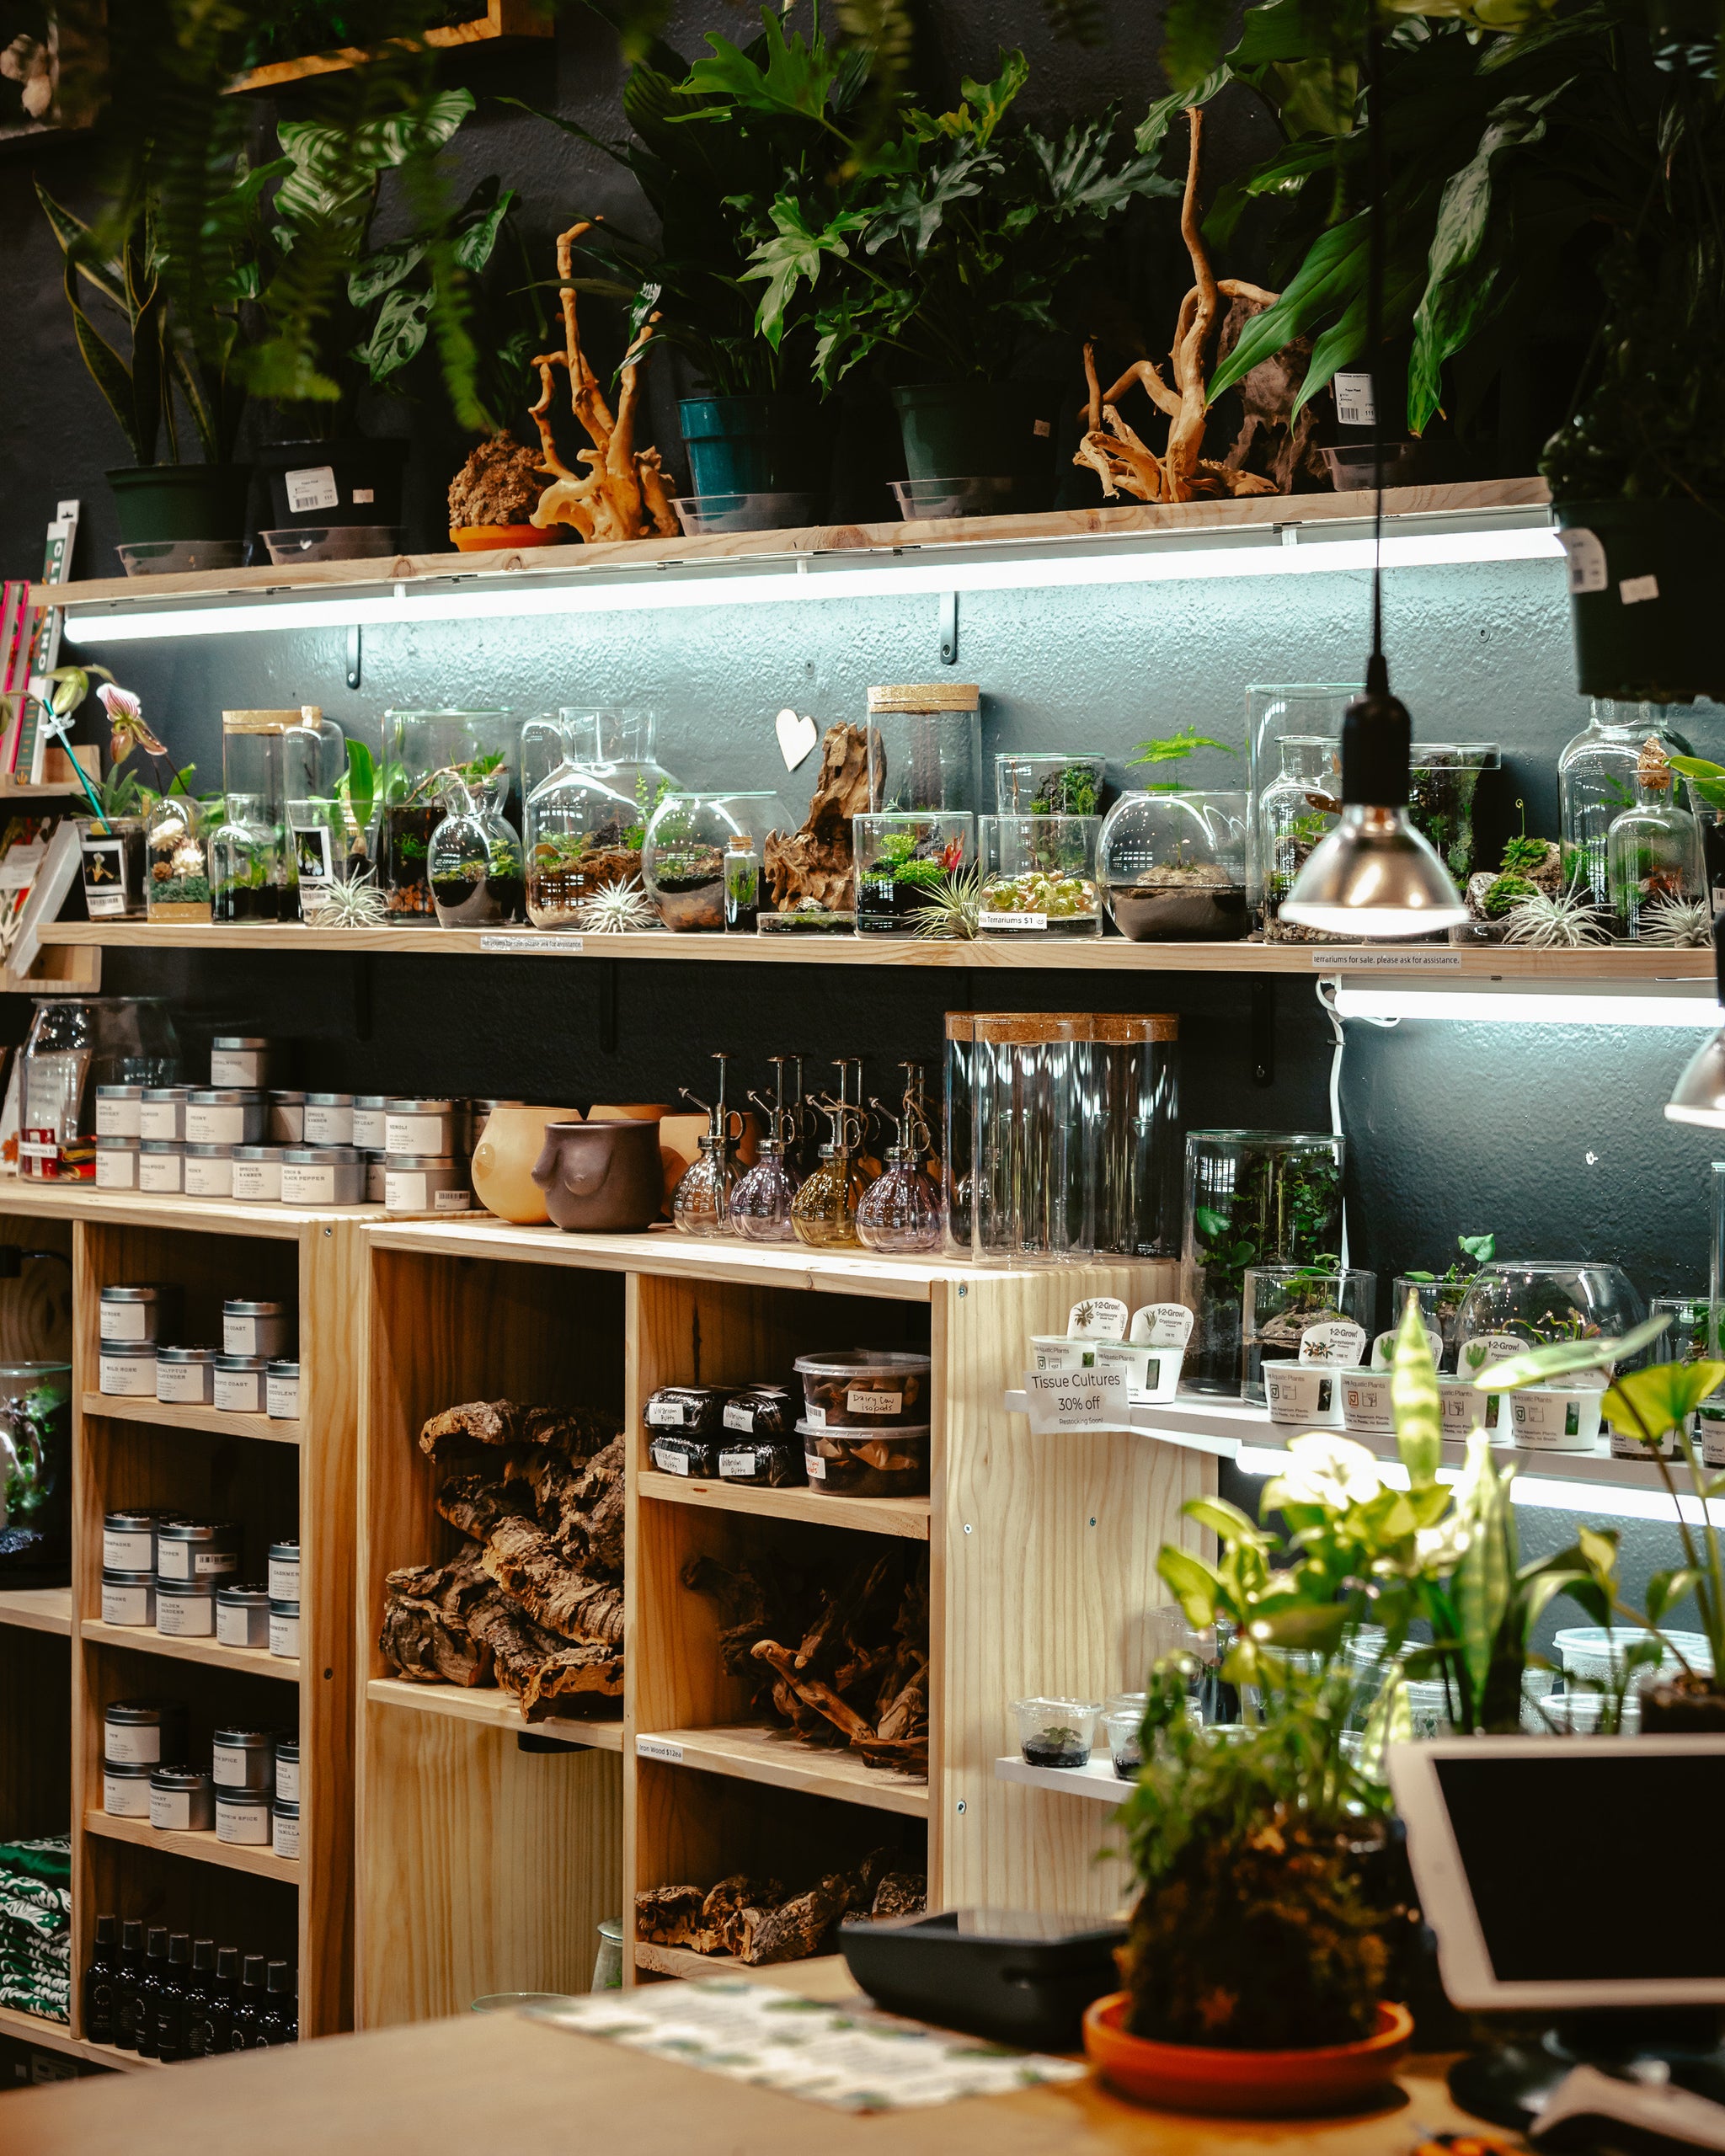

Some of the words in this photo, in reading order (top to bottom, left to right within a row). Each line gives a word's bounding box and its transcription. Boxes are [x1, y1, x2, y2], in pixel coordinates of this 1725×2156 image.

[1313, 955, 1347, 963] terrariums
[1348, 955, 1358, 963] for
[1376, 956, 1398, 965] please
[1412, 956, 1422, 964] for
[1094, 1301, 1120, 1310] 1-2-Grow!
[1157, 1308, 1185, 1318] 1-2-Grow!
[1329, 1327, 1358, 1338] 1-2-Grow!
[1487, 1341, 1520, 1352] 1-2-Grow!
[1031, 1374, 1069, 1389] Tissue
[1071, 1373, 1121, 1387] Cultures
[1287, 1374, 1305, 1382] Plants
[1455, 1390, 1473, 1398] Plants
[852, 1394, 877, 1407] Dairy
[1058, 1397, 1083, 1412] 30%
[1085, 1396, 1100, 1410] off
[1533, 1396, 1552, 1405] Plants
[1059, 1417, 1088, 1426] Restocking
[650, 1746, 665, 1755] Wood
[665, 1748, 682, 1758] $12ea
